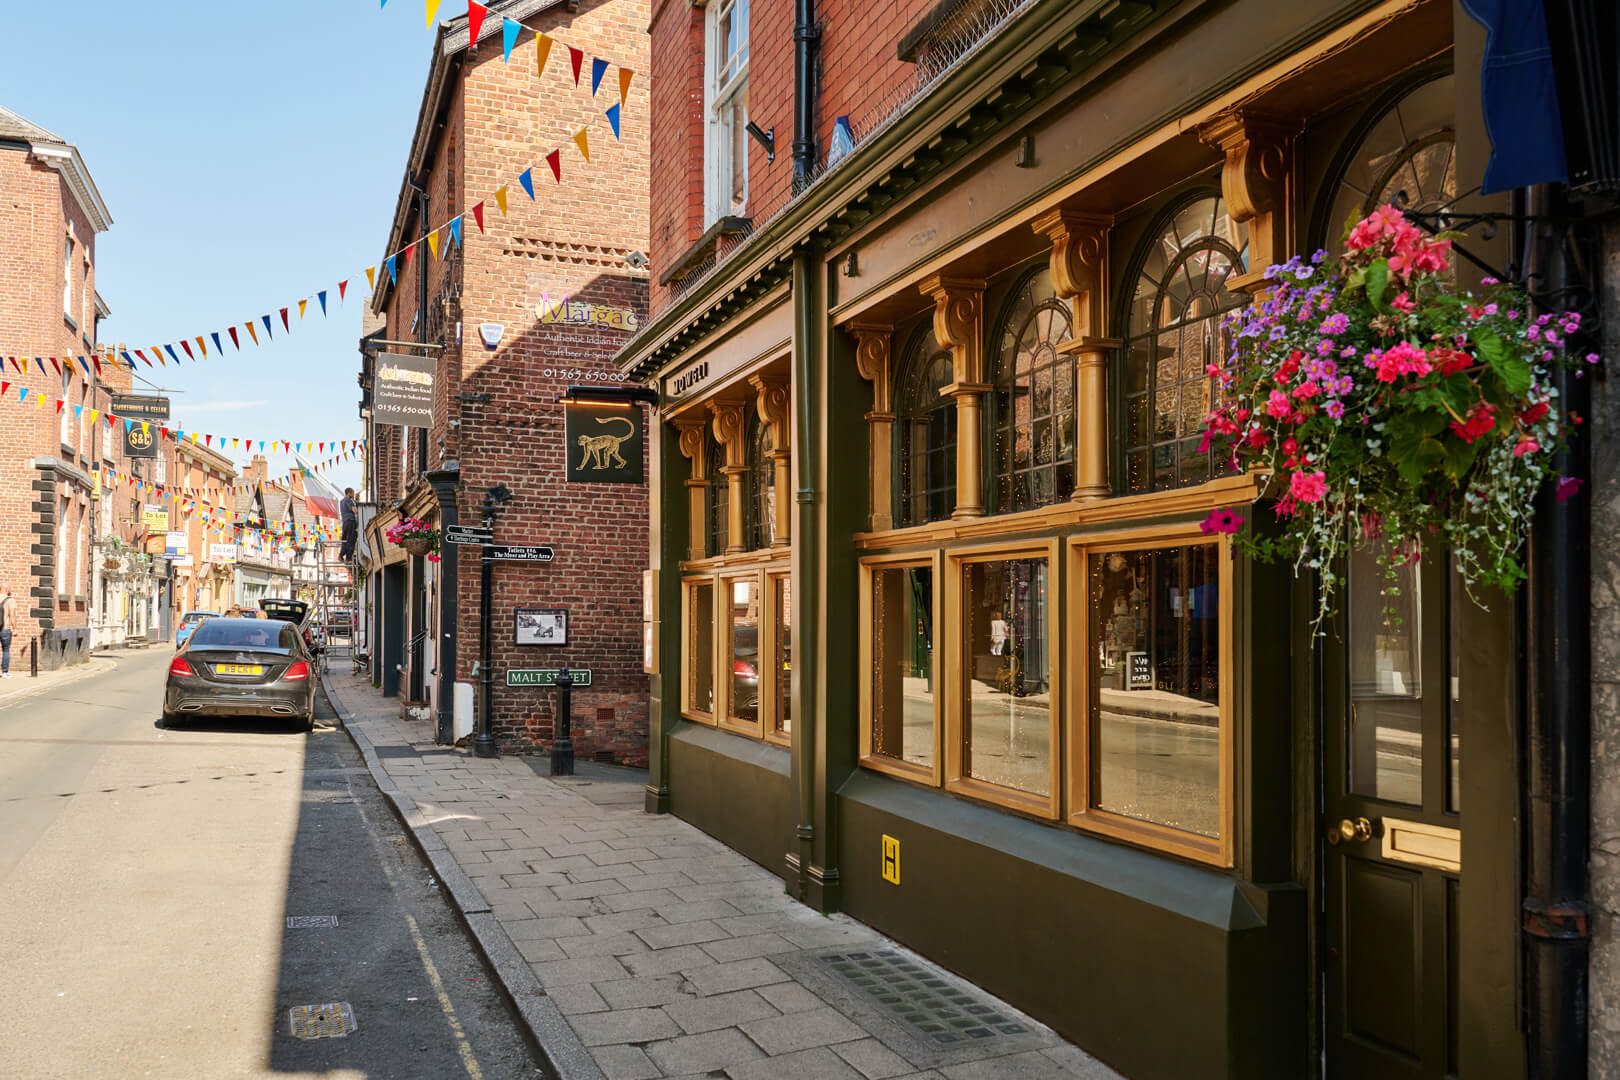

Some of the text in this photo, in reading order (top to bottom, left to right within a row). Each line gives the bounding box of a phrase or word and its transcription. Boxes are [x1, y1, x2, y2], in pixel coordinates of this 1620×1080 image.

[543, 332, 584, 343] Authentic
[586, 335, 612, 345] Indian
[543, 347, 565, 357] Craft
[565, 346, 582, 358] beer
[543, 368, 625, 382] 01565 650 00
[673, 361, 709, 395] MOWGLI
[377, 404, 401, 413] 01565
[402, 405, 417, 414] 650
[131, 432, 150, 445] S&C
[511, 673, 587, 683] MALT STET
[884, 839, 896, 880] H
